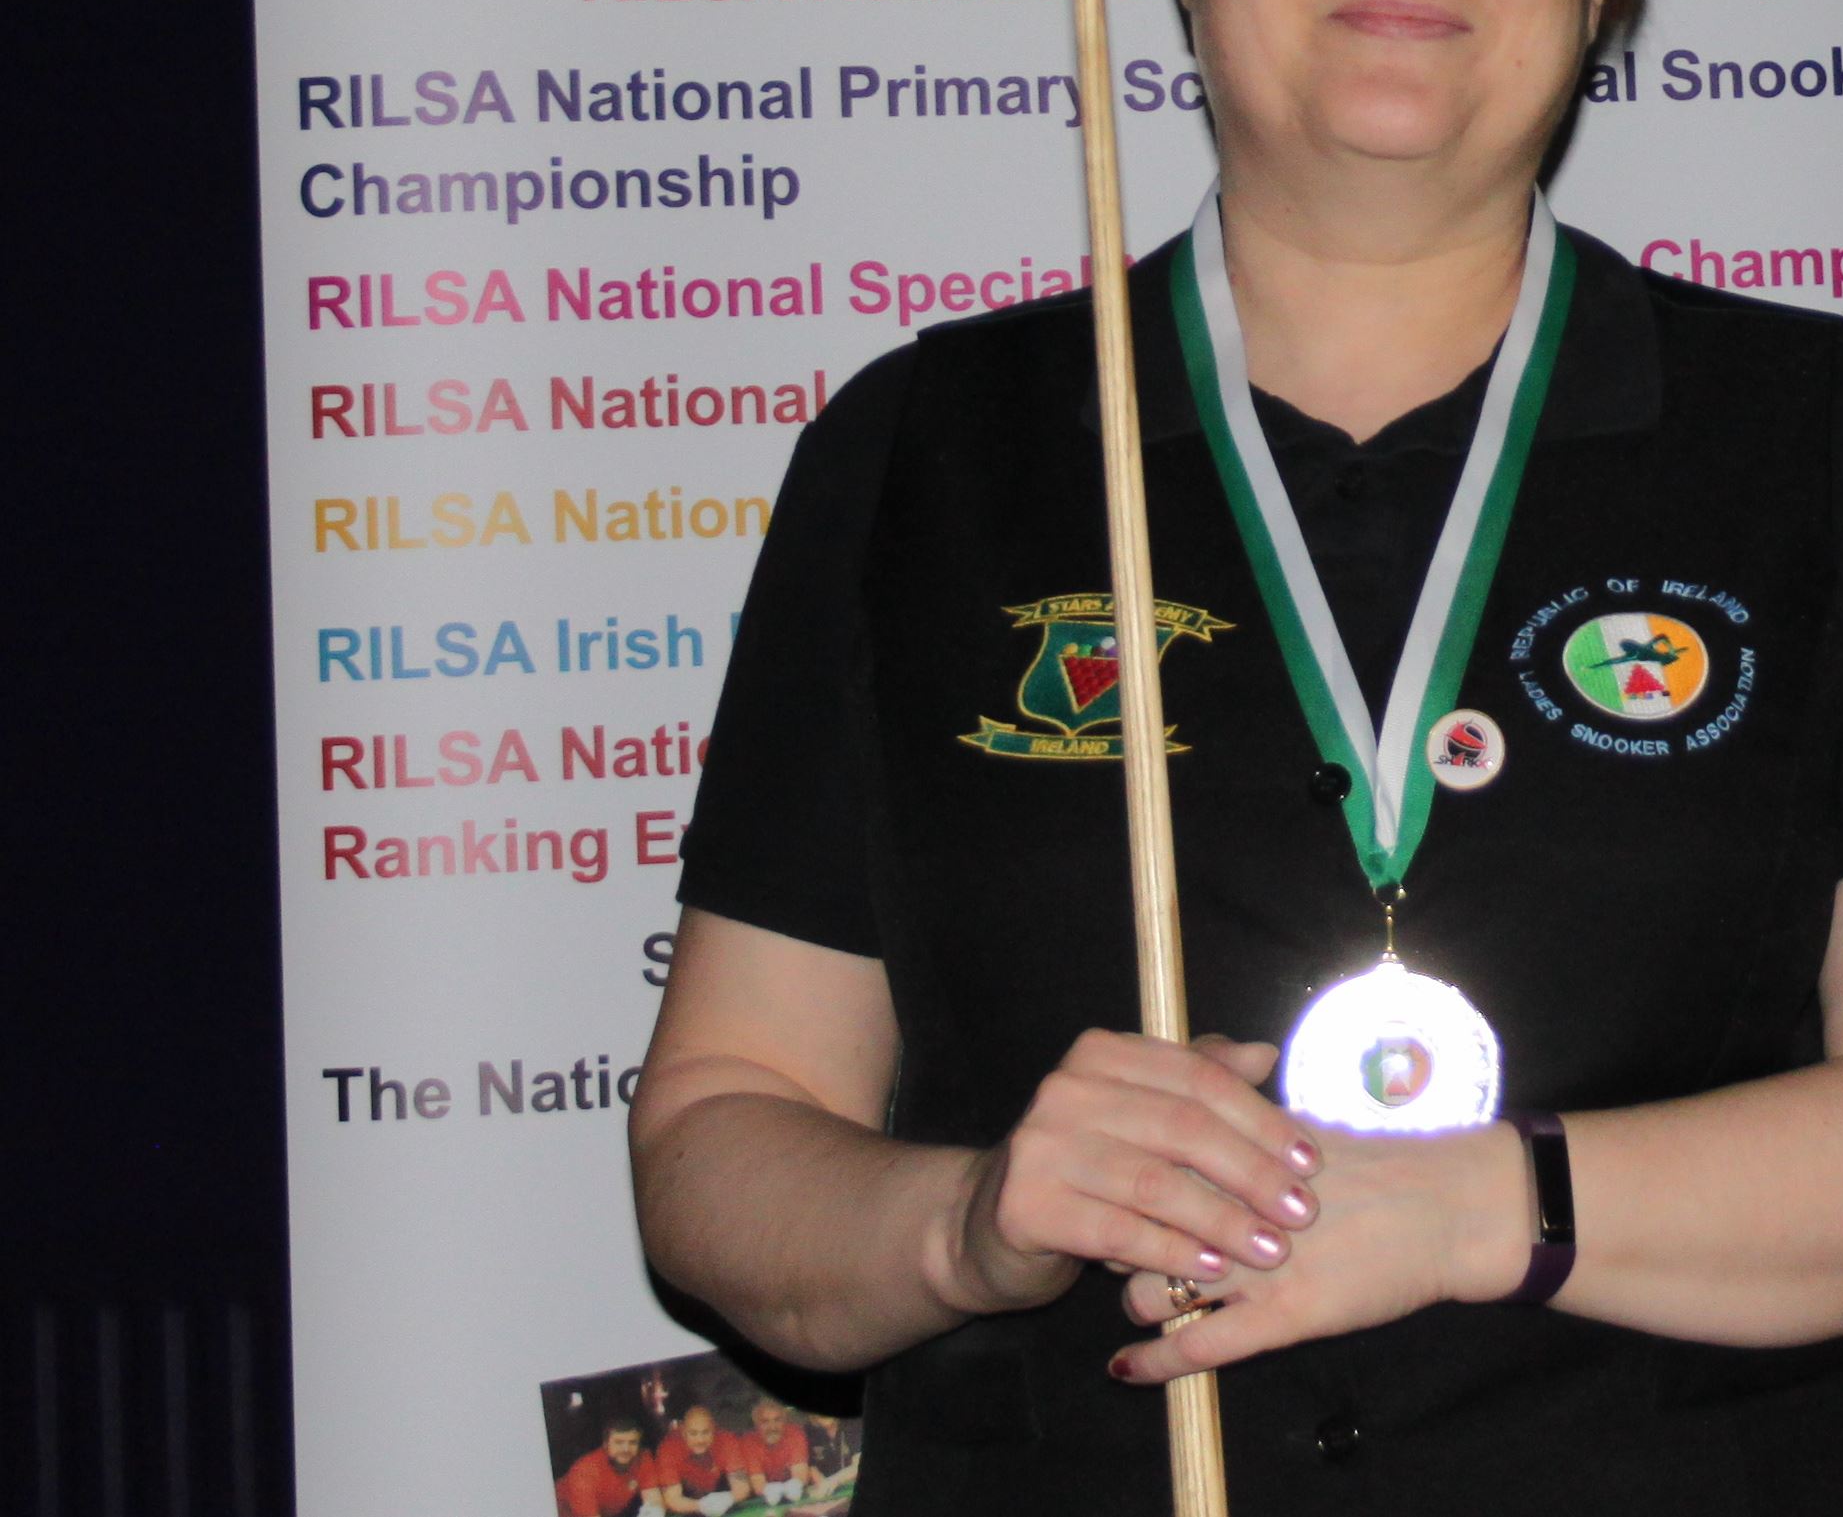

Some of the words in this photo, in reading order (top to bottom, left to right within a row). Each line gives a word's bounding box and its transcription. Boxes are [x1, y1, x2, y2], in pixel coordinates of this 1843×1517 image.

[298, 72, 516, 132] RILSA
[538, 68, 813, 123] National
[841, 64, 1081, 127] Primary
[300, 155, 801, 226] Championship
[308, 271, 526, 332] RILSA
[548, 264, 824, 322] National
[311, 380, 529, 441] RILSA
[551, 371, 826, 431] National
[314, 494, 532, 554] RILSA
[318, 622, 537, 684] RILSA
[558, 616, 704, 674] Irish
[1510, 586, 1589, 660] REPUBLIC
[1606, 578, 1639, 593] OF
[1662, 580, 1749, 624] IRELAND
[1519, 670, 1563, 721] LADIES
[1570, 723, 1671, 756] SNOOKER
[1685, 647, 1755, 751] ASSOCIATION
[321, 731, 540, 793] RILSA
[562, 723, 709, 780] Nati
[1030, 739, 1109, 755] IRELAND
[324, 820, 609, 885] Ranking
[637, 811, 688, 866] E
[323, 1068, 451, 1124] The
